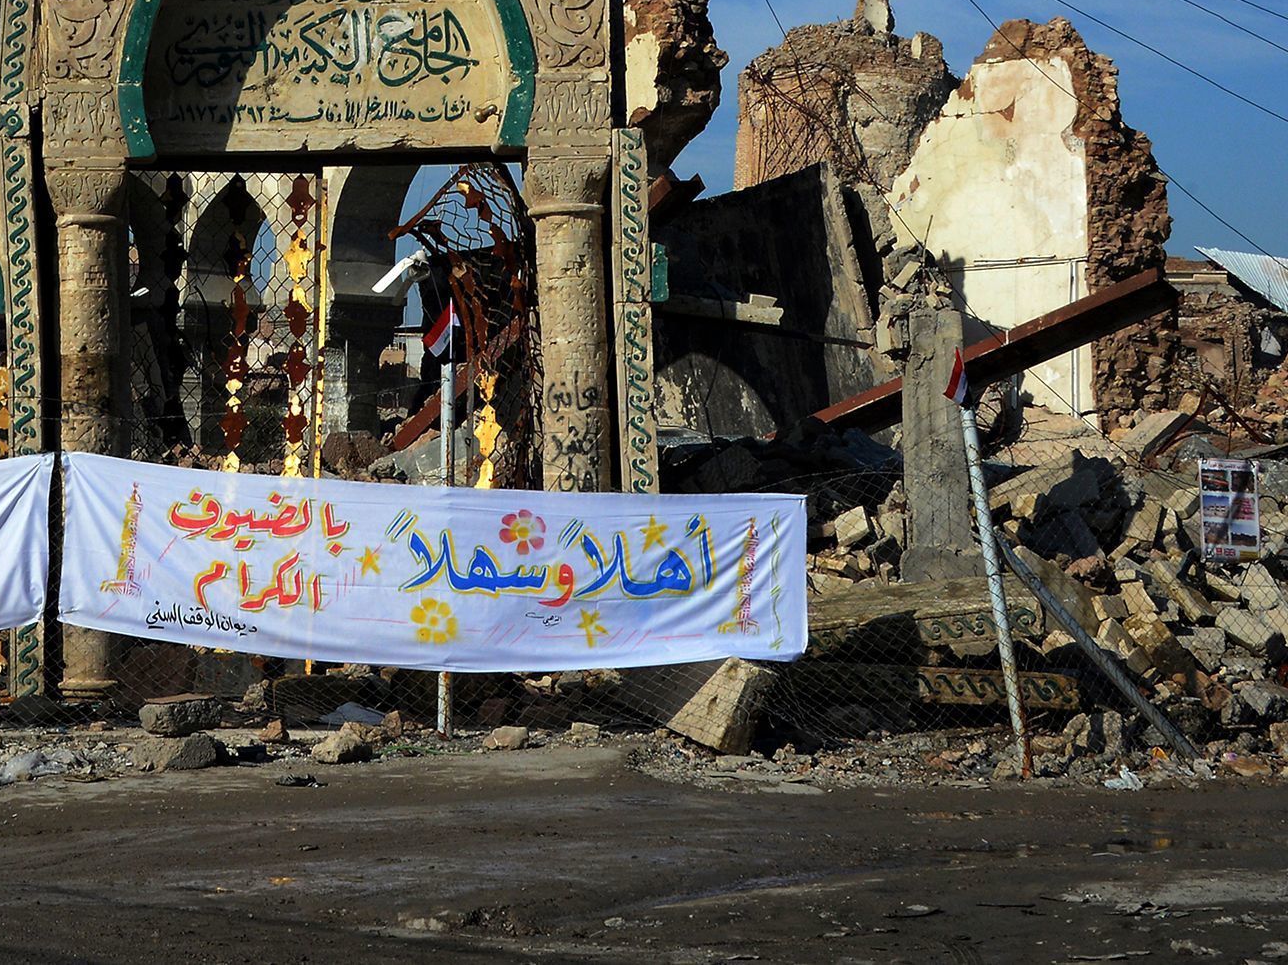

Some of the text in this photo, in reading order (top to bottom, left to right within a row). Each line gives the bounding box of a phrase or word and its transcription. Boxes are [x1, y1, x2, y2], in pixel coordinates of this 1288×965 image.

[378, 8, 480, 87] الجامع
[194, 547, 325, 616] الكرام
[145, 600, 258, 636] ديوان الوقف السني
